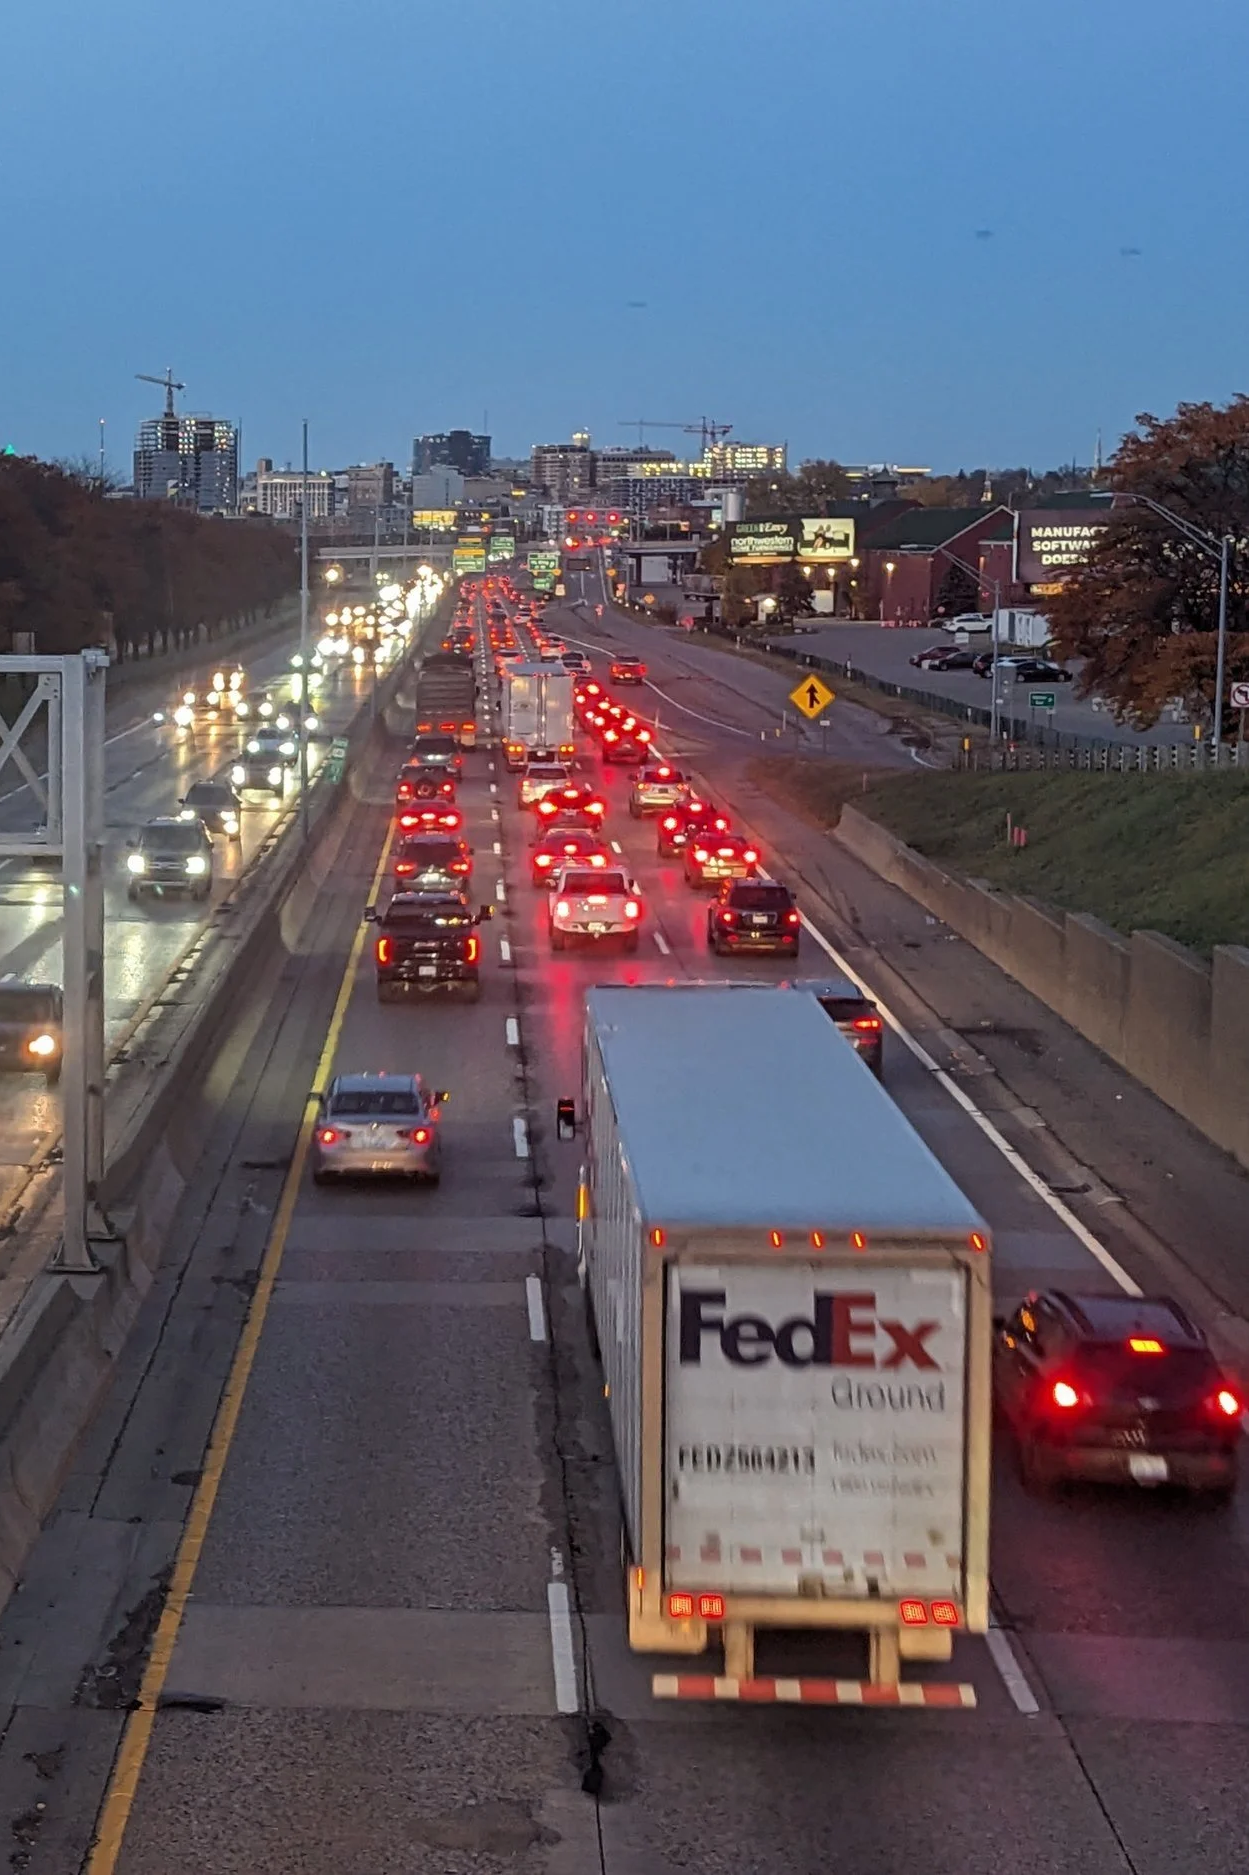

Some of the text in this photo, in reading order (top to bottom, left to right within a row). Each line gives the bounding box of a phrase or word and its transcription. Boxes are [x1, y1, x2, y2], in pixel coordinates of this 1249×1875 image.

[731, 535, 795, 546] northwestern
[680, 1289, 942, 1372] FedEx
[831, 1373, 945, 1413] Ground
